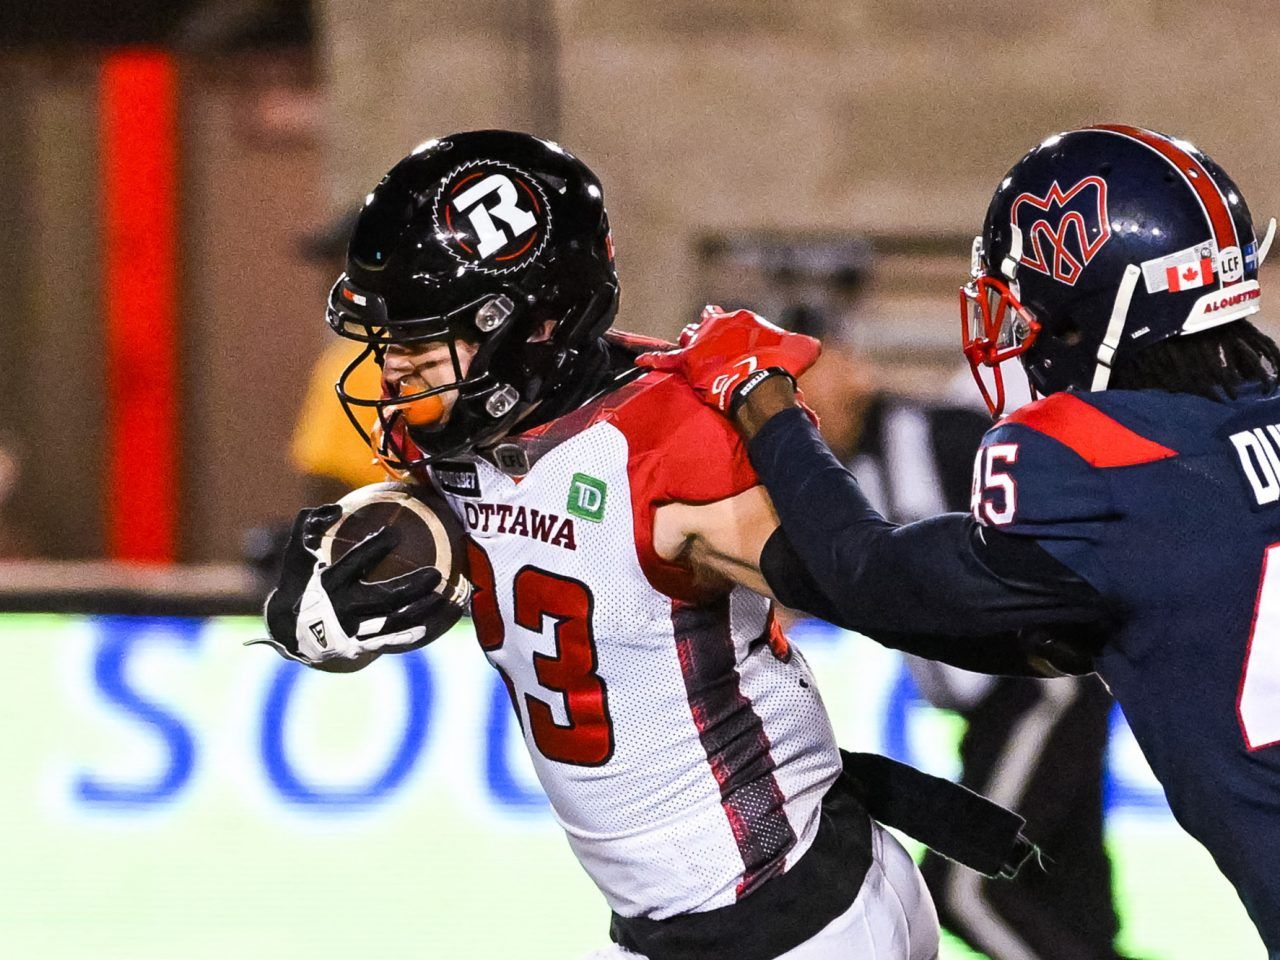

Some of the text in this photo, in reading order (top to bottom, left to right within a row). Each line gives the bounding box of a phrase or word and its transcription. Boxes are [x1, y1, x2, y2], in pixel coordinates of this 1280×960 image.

[452, 173, 538, 260] R
[1221, 255, 1239, 274] LCF
[574, 480, 603, 514] TD
[463, 502, 578, 551] OTTAWA
